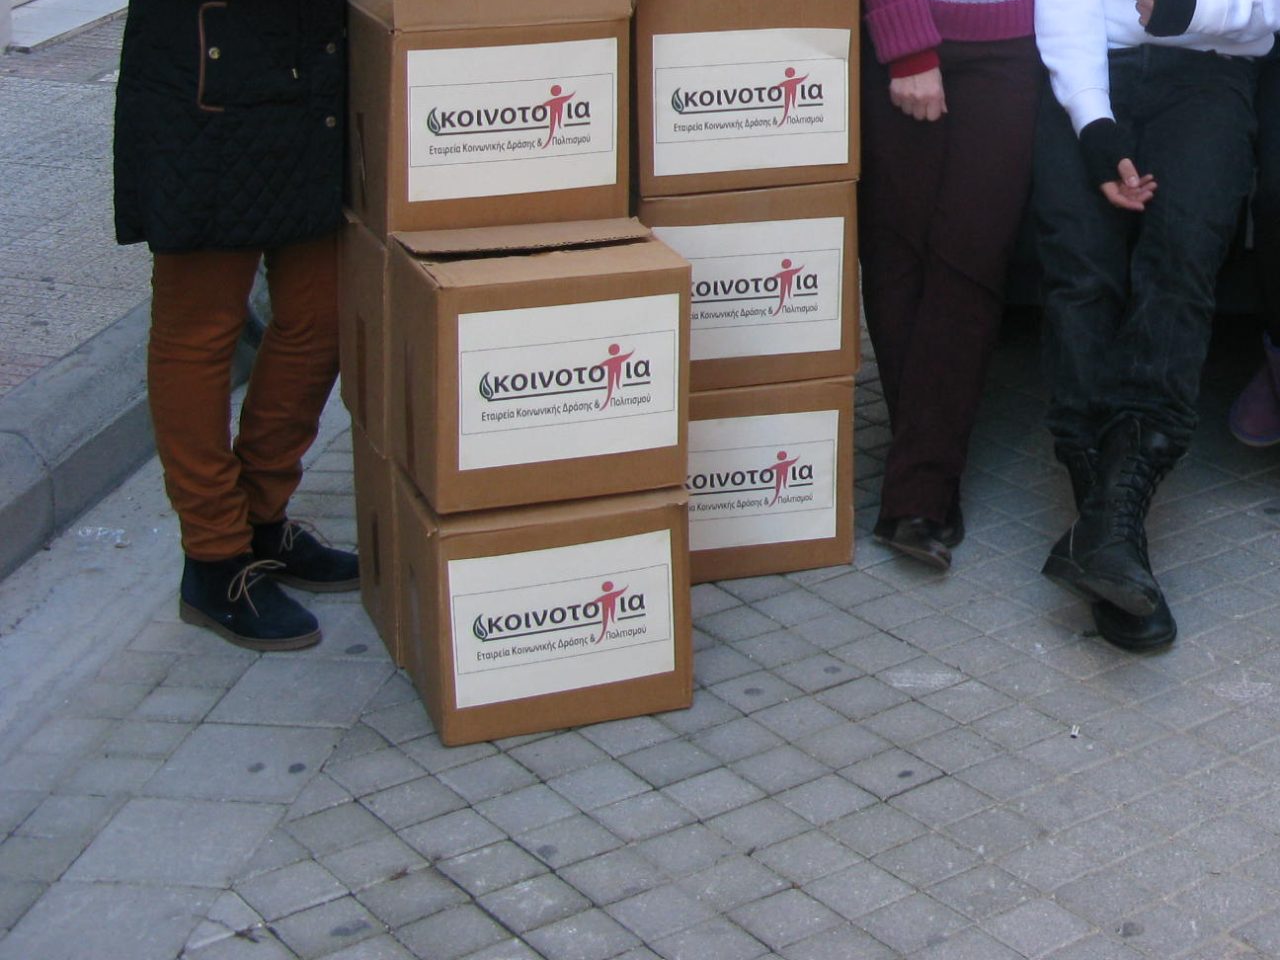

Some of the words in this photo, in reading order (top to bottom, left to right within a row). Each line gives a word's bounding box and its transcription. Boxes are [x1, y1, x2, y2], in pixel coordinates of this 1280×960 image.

[673, 122, 703, 134] Εταιρεία
[704, 120, 744, 131] Κοινωνικής
[744, 117, 772, 128] Δράσης
[772, 116, 778, 126] &
[786, 113, 824, 126] Πολιτισμού
[429, 145, 461, 157] Εταιρεία
[462, 142, 506, 155] Κοινωνικής
[506, 139, 535, 151] Δράσης
[536, 139, 543, 147] &
[552, 135, 591, 148] Πολιτισμού
[700, 308, 740, 320] Κοινωνικής
[740, 307, 767, 318] Δράσης
[782, 302, 819, 315] Πολιτισμού
[482, 409, 515, 424] Εταιρεία
[516, 404, 561, 419] Κοινωνικής
[562, 401, 593, 415] Δράσης
[593, 401, 600, 409] &
[610, 393, 651, 408] Πολιτισμού
[696, 500, 735, 512] Κοινωνικής
[736, 498, 763, 510] Δράσης
[764, 496, 769, 506] &
[777, 492, 814, 505] Πολιτισμού
[477, 648, 511, 662] Εταιρεία
[511, 642, 557, 657] Κοινωνικής
[558, 637, 589, 651] Δράσης
[589, 633, 596, 643] &
[605, 625, 647, 640] Πολιτισμού
